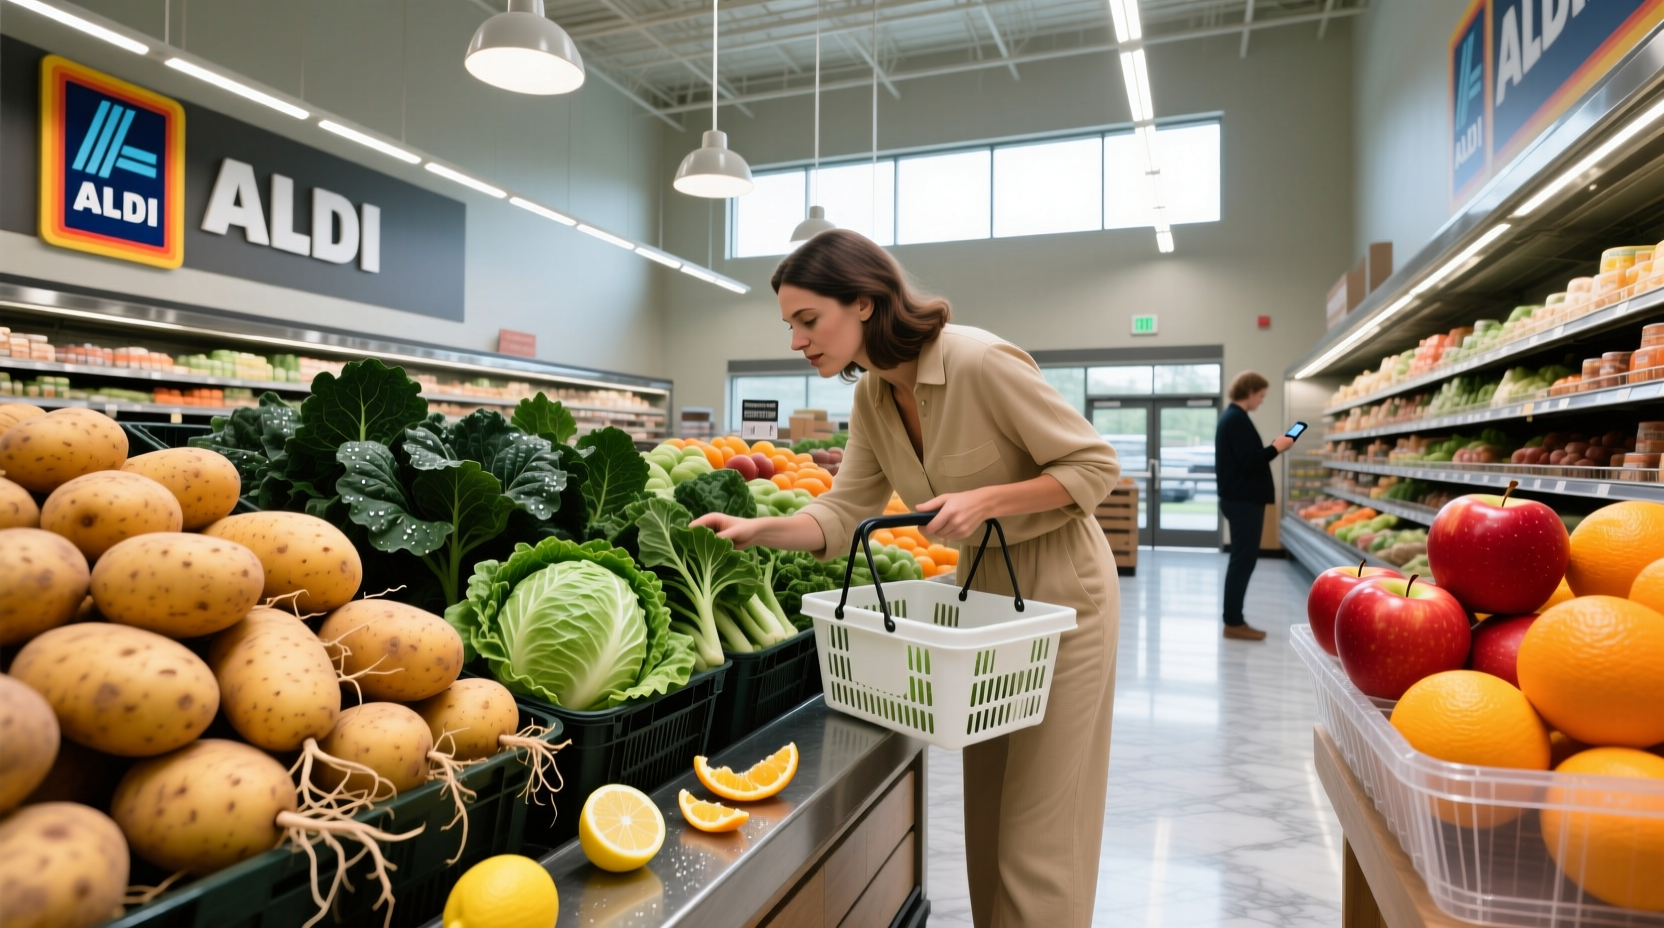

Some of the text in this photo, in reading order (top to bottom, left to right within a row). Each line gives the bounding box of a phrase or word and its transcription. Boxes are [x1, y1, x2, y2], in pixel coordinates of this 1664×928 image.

[1495, 0, 1586, 108] AL
[1454, 115, 1483, 171] ALDI
[72, 181, 159, 228] ALDI
[201, 158, 381, 274] ALDI
